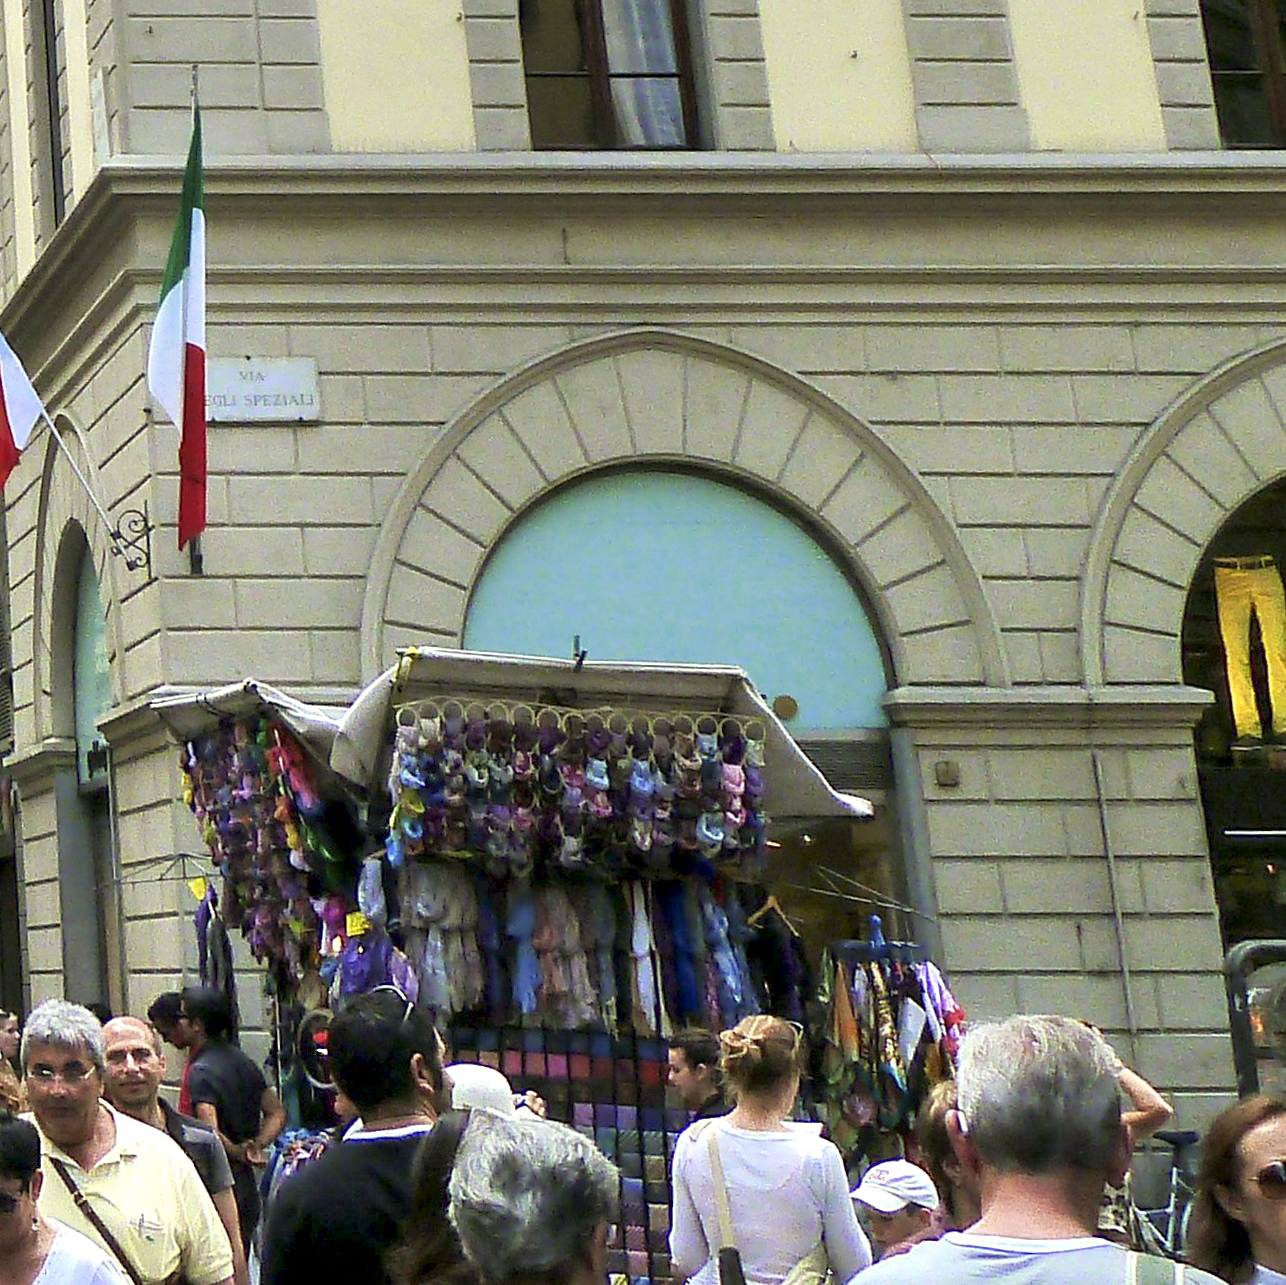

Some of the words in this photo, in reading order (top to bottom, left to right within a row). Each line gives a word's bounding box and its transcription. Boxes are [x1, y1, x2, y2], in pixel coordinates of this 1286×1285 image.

[239, 370, 265, 382] VIA
[205, 394, 237, 407] EGLI
[244, 394, 314, 407] SPEZIALI
